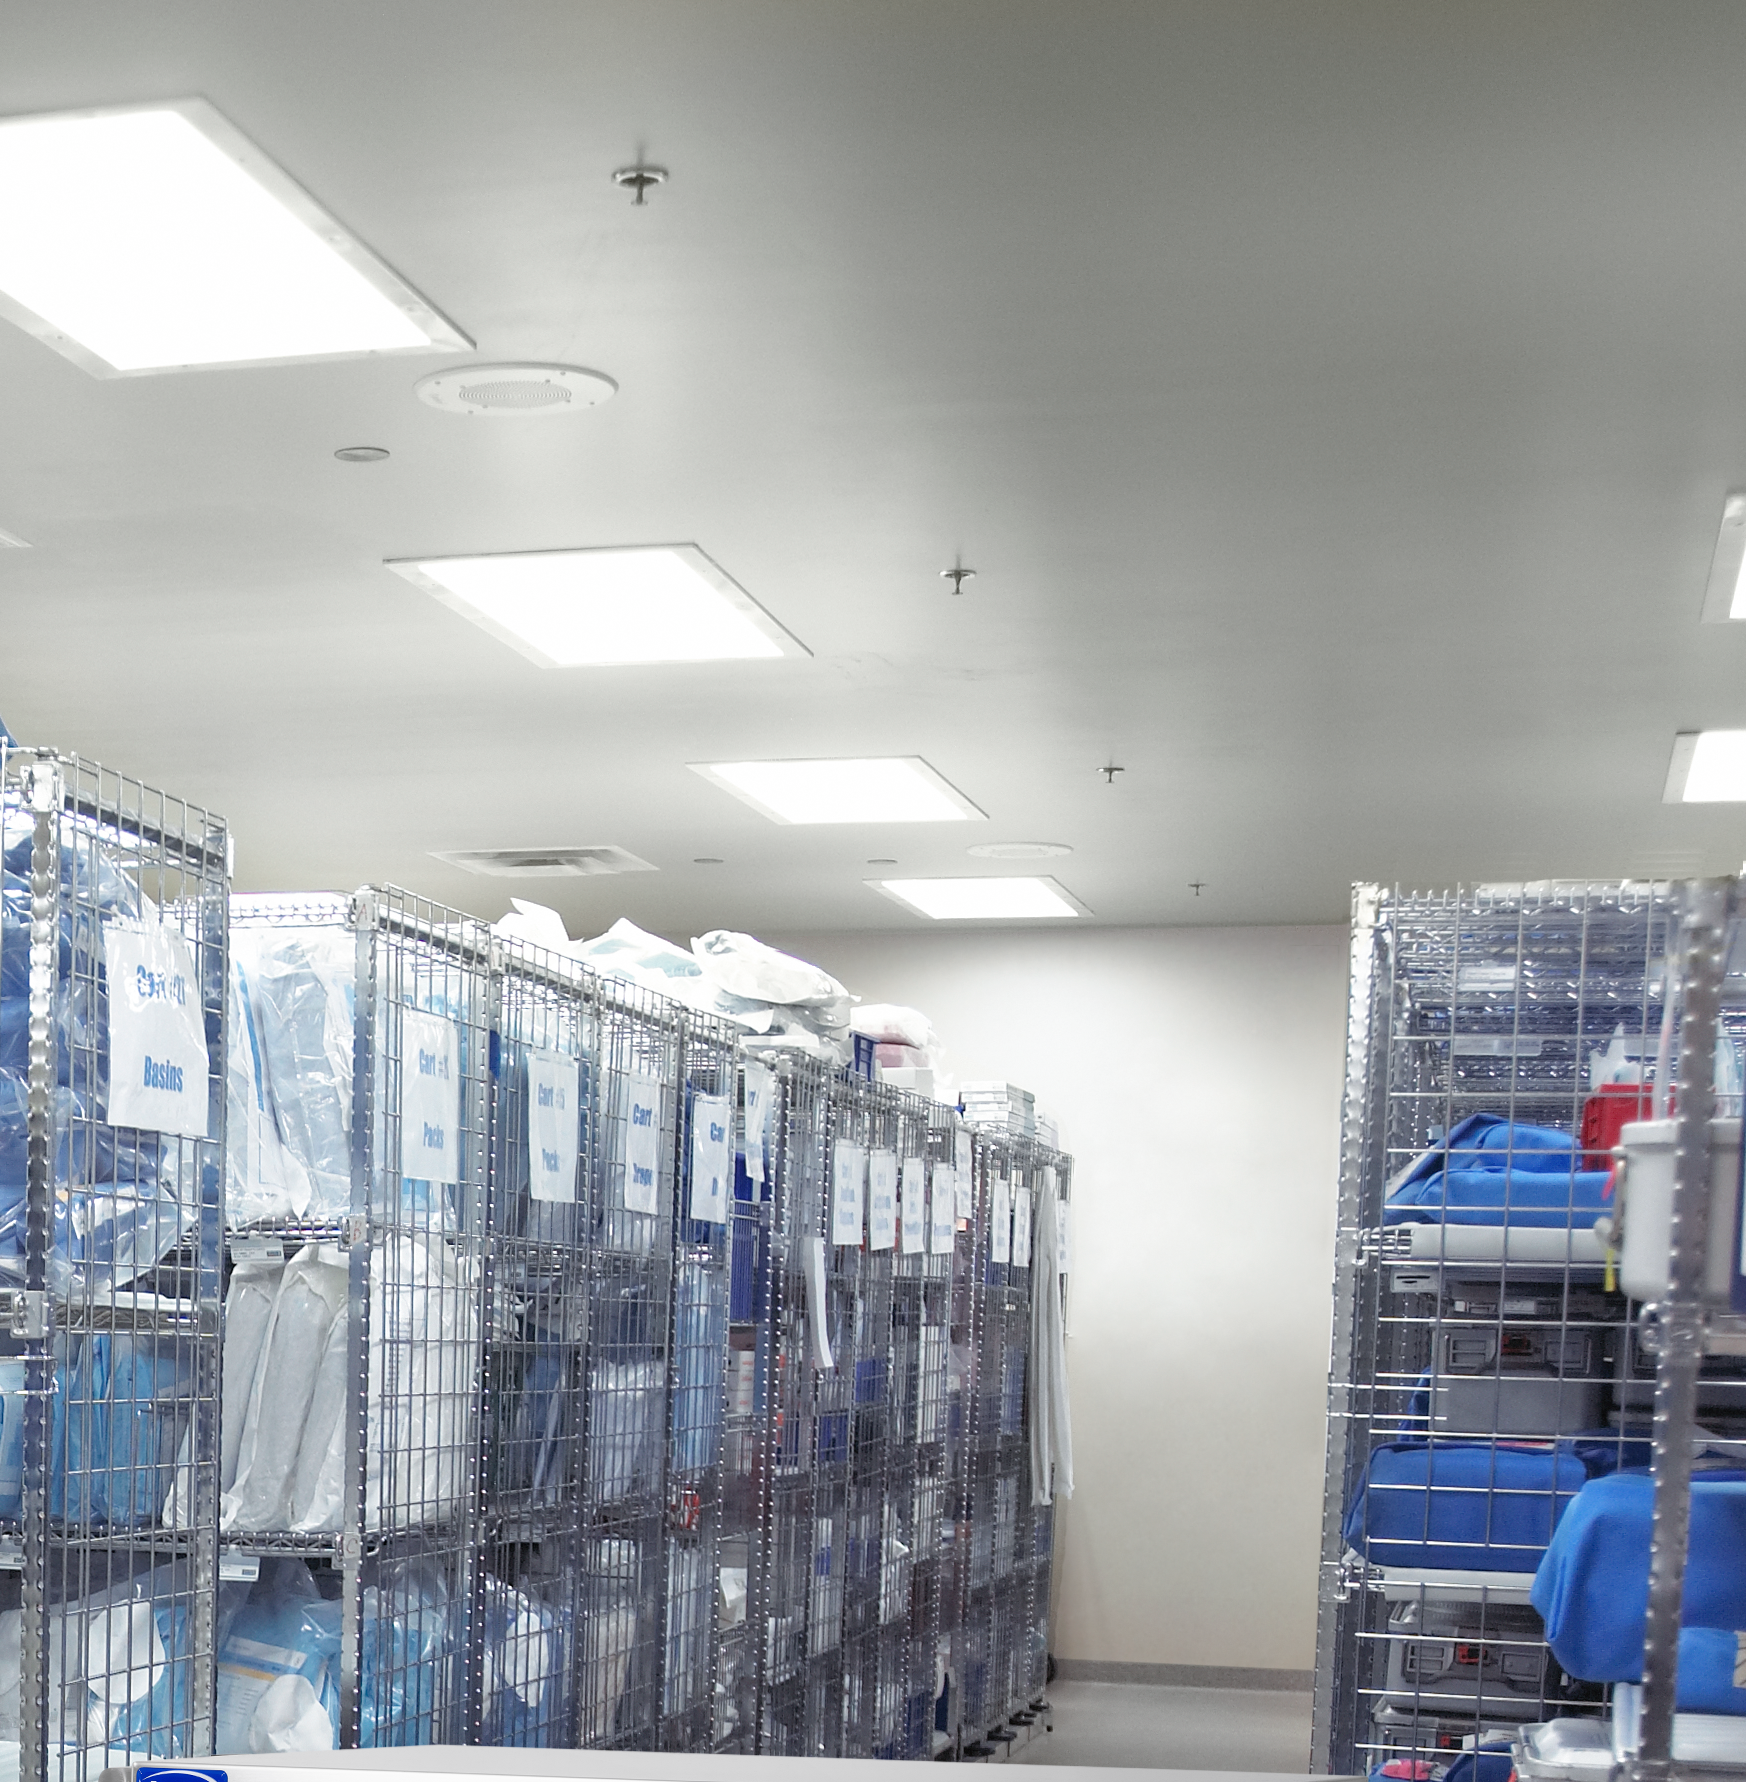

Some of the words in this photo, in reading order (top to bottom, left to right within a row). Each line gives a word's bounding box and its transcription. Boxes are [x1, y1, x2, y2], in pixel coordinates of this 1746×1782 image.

[143, 1055, 184, 1093] Basins
[419, 1048, 436, 1077] Cart
[633, 1103, 652, 1127] Cart
[423, 1121, 444, 1149] Packs
